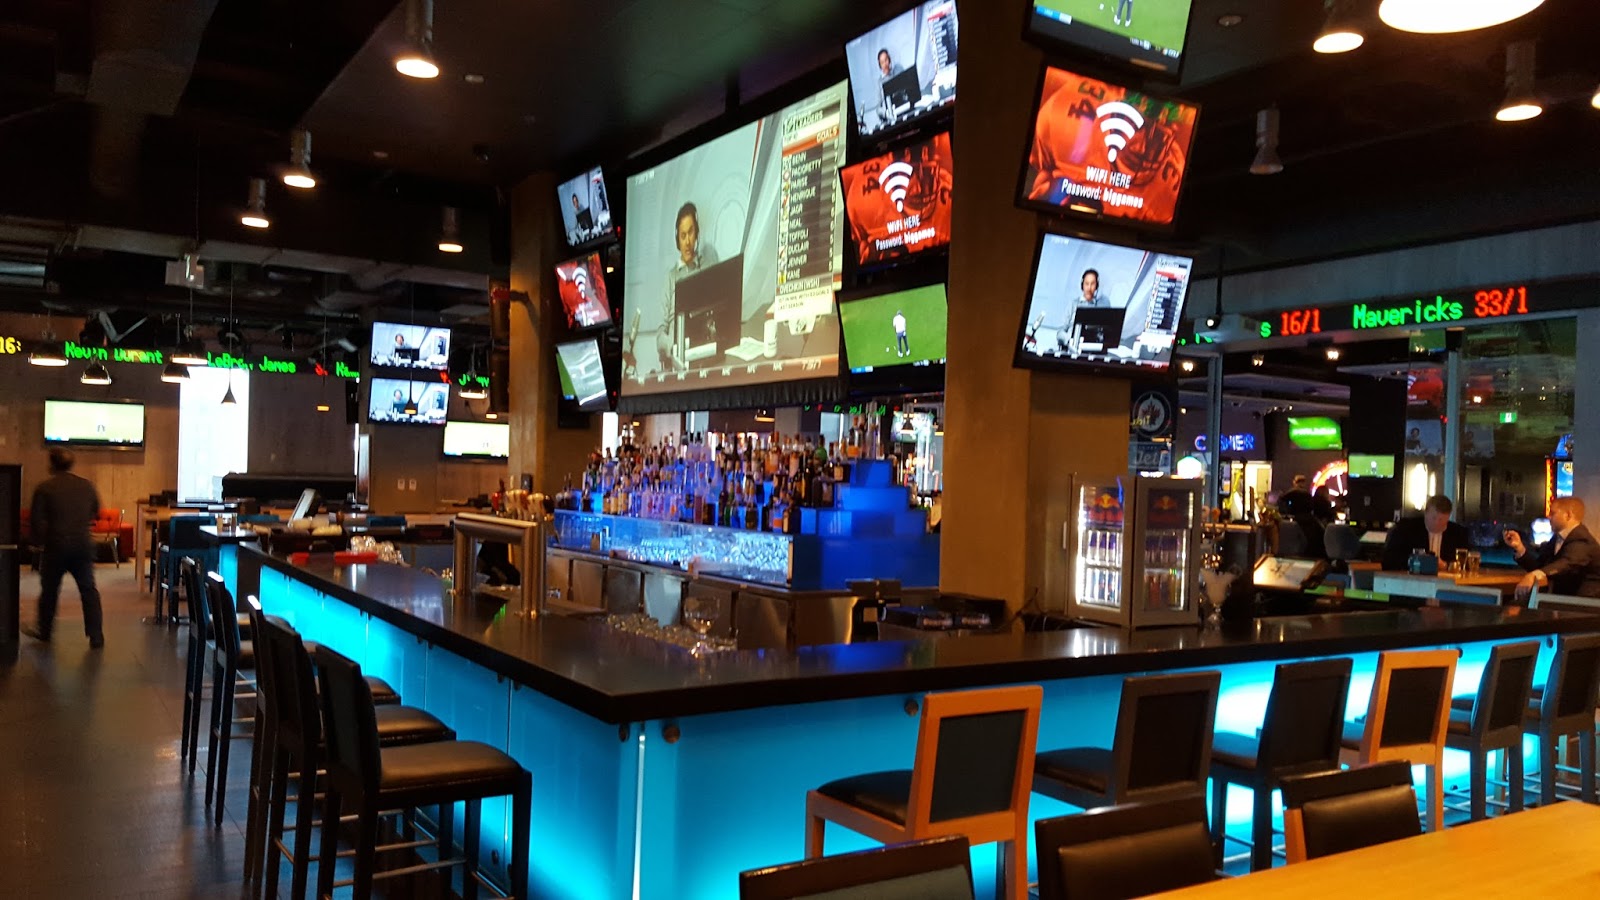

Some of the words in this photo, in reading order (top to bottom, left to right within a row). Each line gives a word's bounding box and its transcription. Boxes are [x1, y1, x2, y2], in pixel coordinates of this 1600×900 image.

[816, 126, 838, 143] GOALS
[1109, 171, 1132, 190] HERE
[1061, 178, 1102, 201] Password:
[1102, 187, 1144, 209] biggames
[903, 214, 921, 230] HERE
[786, 268, 800, 281] KANE
[1281, 308, 1321, 336] 16/1
[1353, 296, 1463, 329] Mavericks
[1474, 286, 1528, 318] 33/1
[259, 355, 296, 374] James
